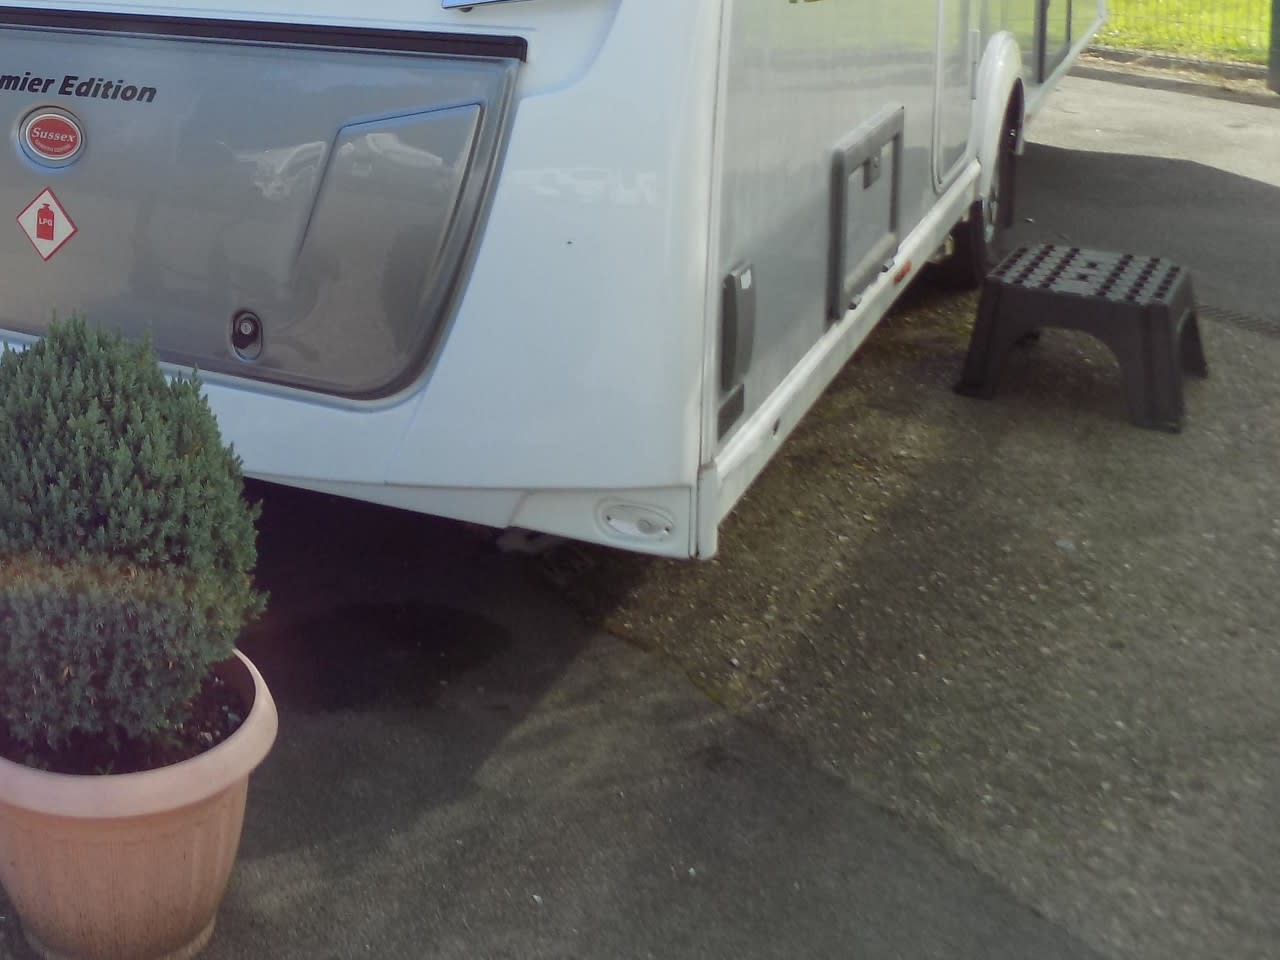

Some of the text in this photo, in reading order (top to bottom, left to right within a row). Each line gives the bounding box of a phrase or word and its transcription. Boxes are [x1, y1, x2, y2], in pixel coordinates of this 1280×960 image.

[57, 74, 157, 103] Edition
[31, 127, 76, 143] Sussex
[38, 217, 53, 227] LPG
